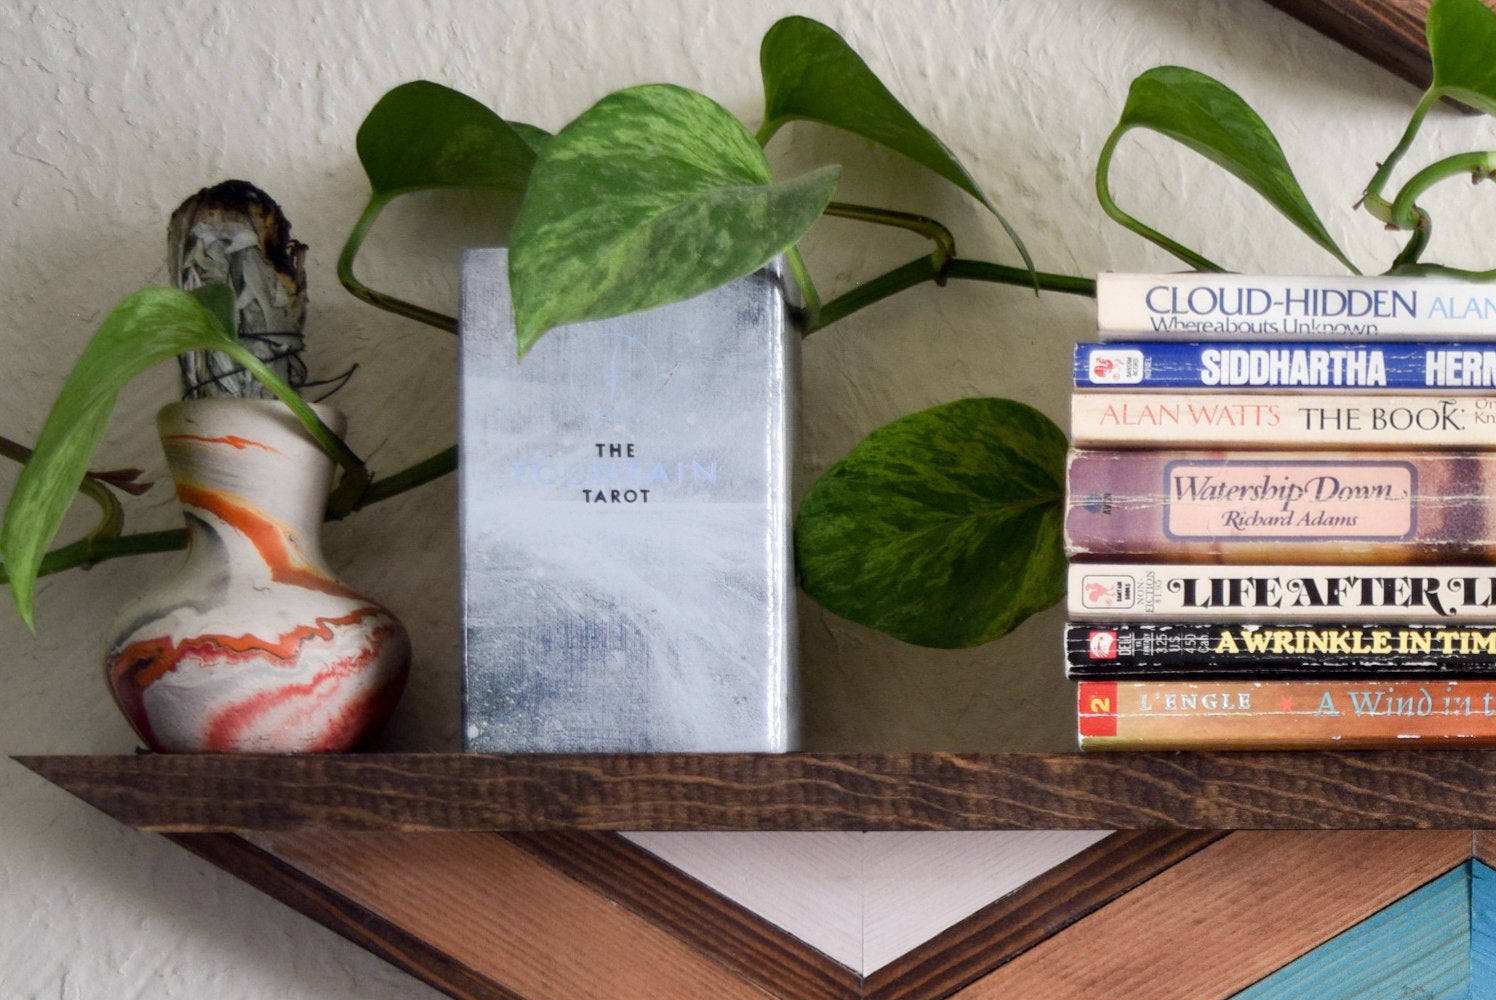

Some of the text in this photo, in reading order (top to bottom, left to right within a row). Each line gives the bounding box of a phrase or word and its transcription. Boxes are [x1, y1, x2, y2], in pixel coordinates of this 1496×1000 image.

[1145, 285, 1418, 319] CLOUD-HIDDEN
[1150, 315, 1379, 336] Whereabouts Unknown
[1200, 349, 1388, 387] SIDDHARTHA
[1100, 403, 1180, 426] ALAN
[1187, 404, 1282, 427] WATTS
[1298, 407, 1363, 431] THE
[595, 443, 636, 458] THE
[582, 489, 651, 504] TAROT
[1173, 474, 1392, 512] Watership Down
[1221, 510, 1359, 531] Richard Adams
[1167, 577, 1283, 609] LIFE
[1286, 576, 1457, 617] AFTER
[1118, 633, 1132, 656] DELL
[1156, 634, 1168, 654] 3.25
[1169, 633, 1180, 652] U.S.
[1198, 632, 1210, 653] Can.
[1215, 630, 1240, 654] A
[1240, 630, 1393, 654] WRINKLE
[1398, 631, 1431, 654] IN
[1091, 697, 1110, 713] 2
[1312, 691, 1341, 717] A
[1348, 687, 1433, 717] Wind
[1443, 687, 1471, 716] in
